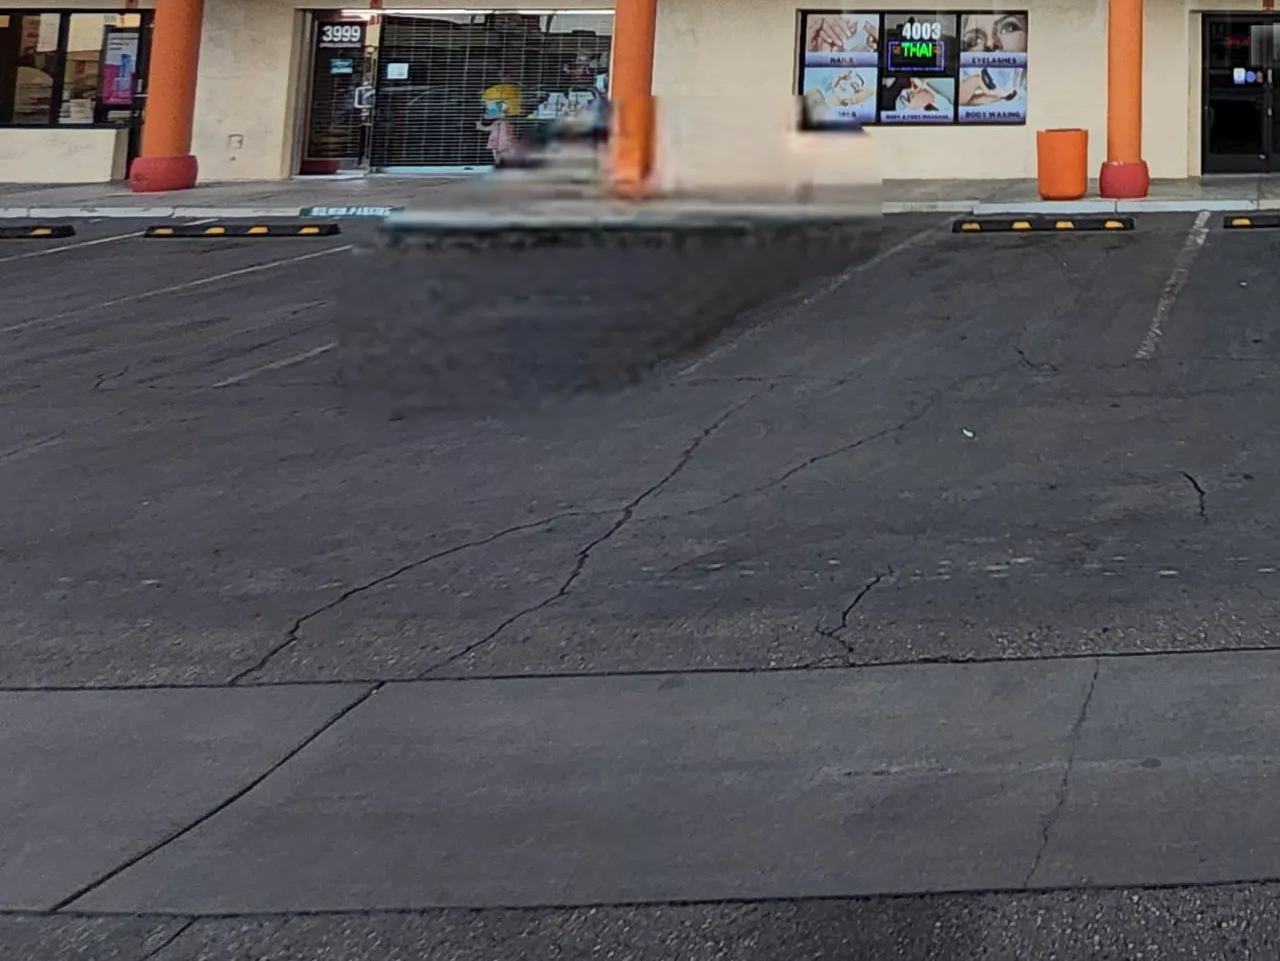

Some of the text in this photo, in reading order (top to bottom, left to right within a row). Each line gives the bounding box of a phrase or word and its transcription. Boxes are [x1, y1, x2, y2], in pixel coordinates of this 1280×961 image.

[322, 25, 361, 42] 3999
[902, 22, 942, 40] 4003
[901, 42, 932, 58] THAI
